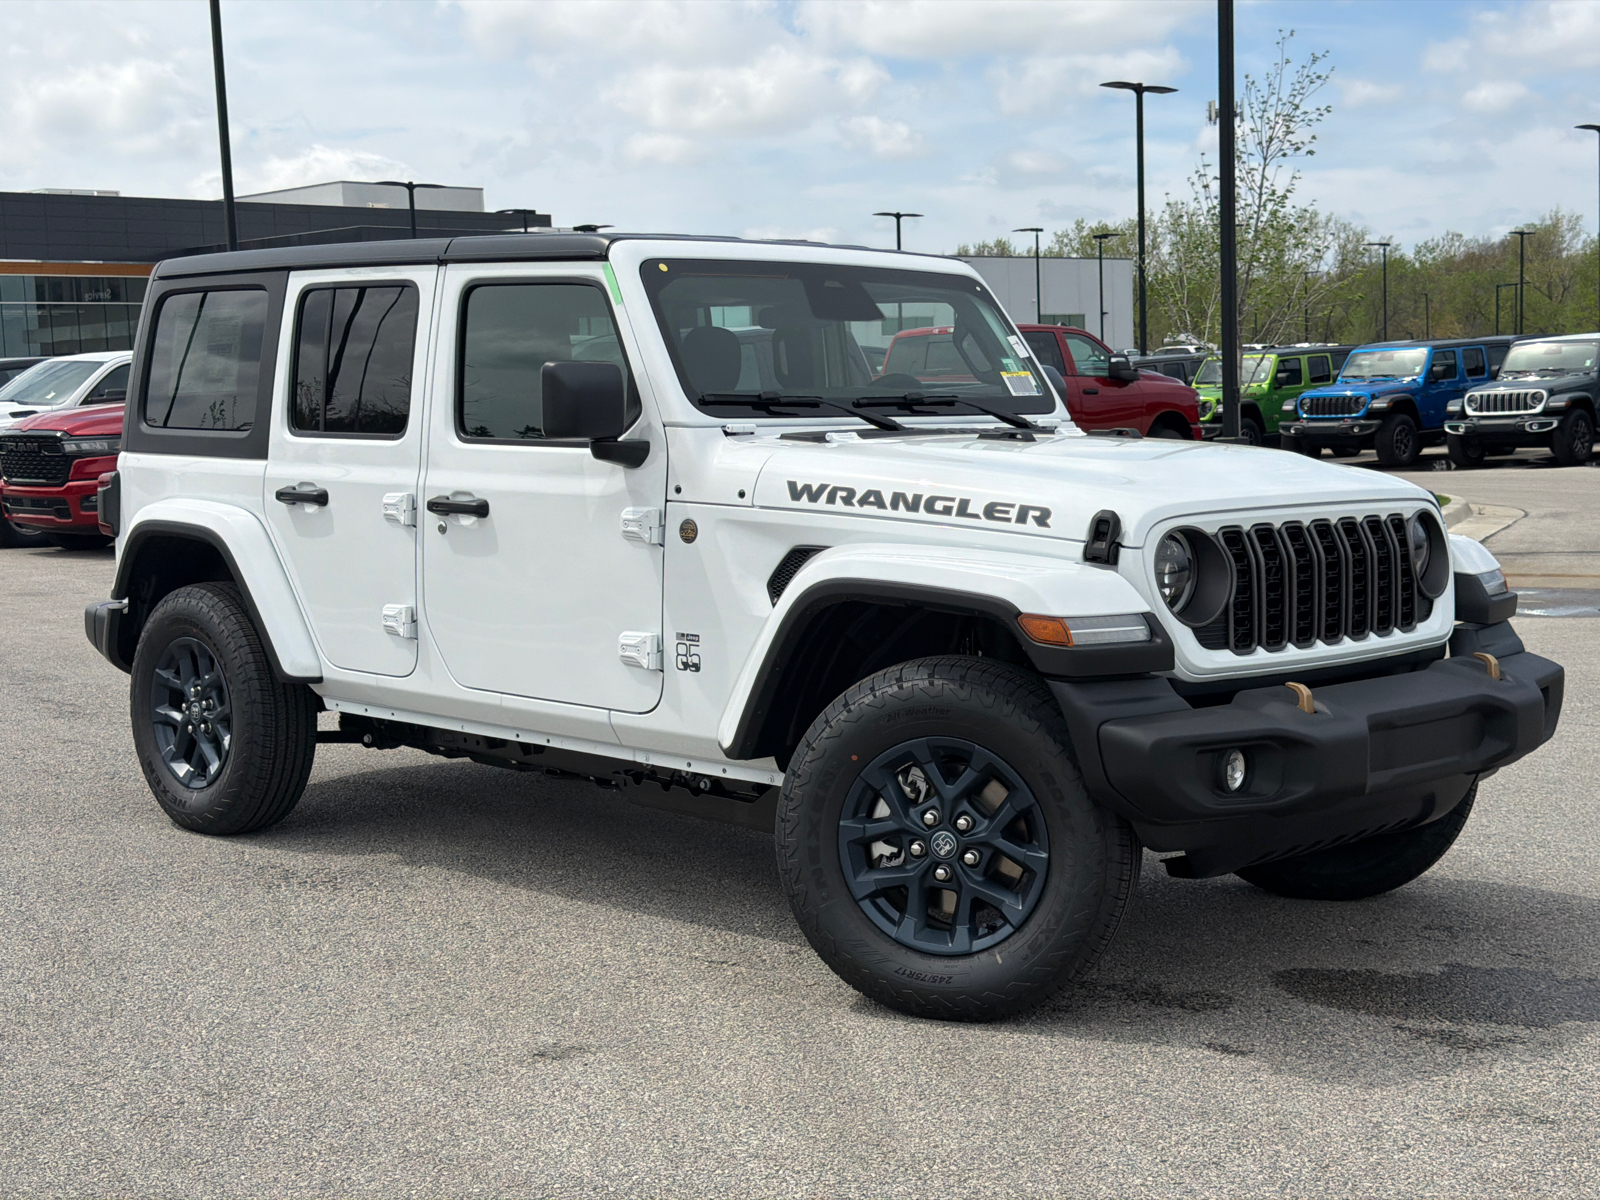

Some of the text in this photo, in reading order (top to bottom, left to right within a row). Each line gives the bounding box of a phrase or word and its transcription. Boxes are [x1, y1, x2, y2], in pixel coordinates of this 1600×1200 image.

[8, 442, 39, 452] RAM
[787, 480, 1053, 529] WRANGLER
[686, 634, 700, 642] Jeep
[676, 642, 701, 673] 85
[933, 834, 954, 856] 85
[894, 966, 954, 985] 245/75R17
